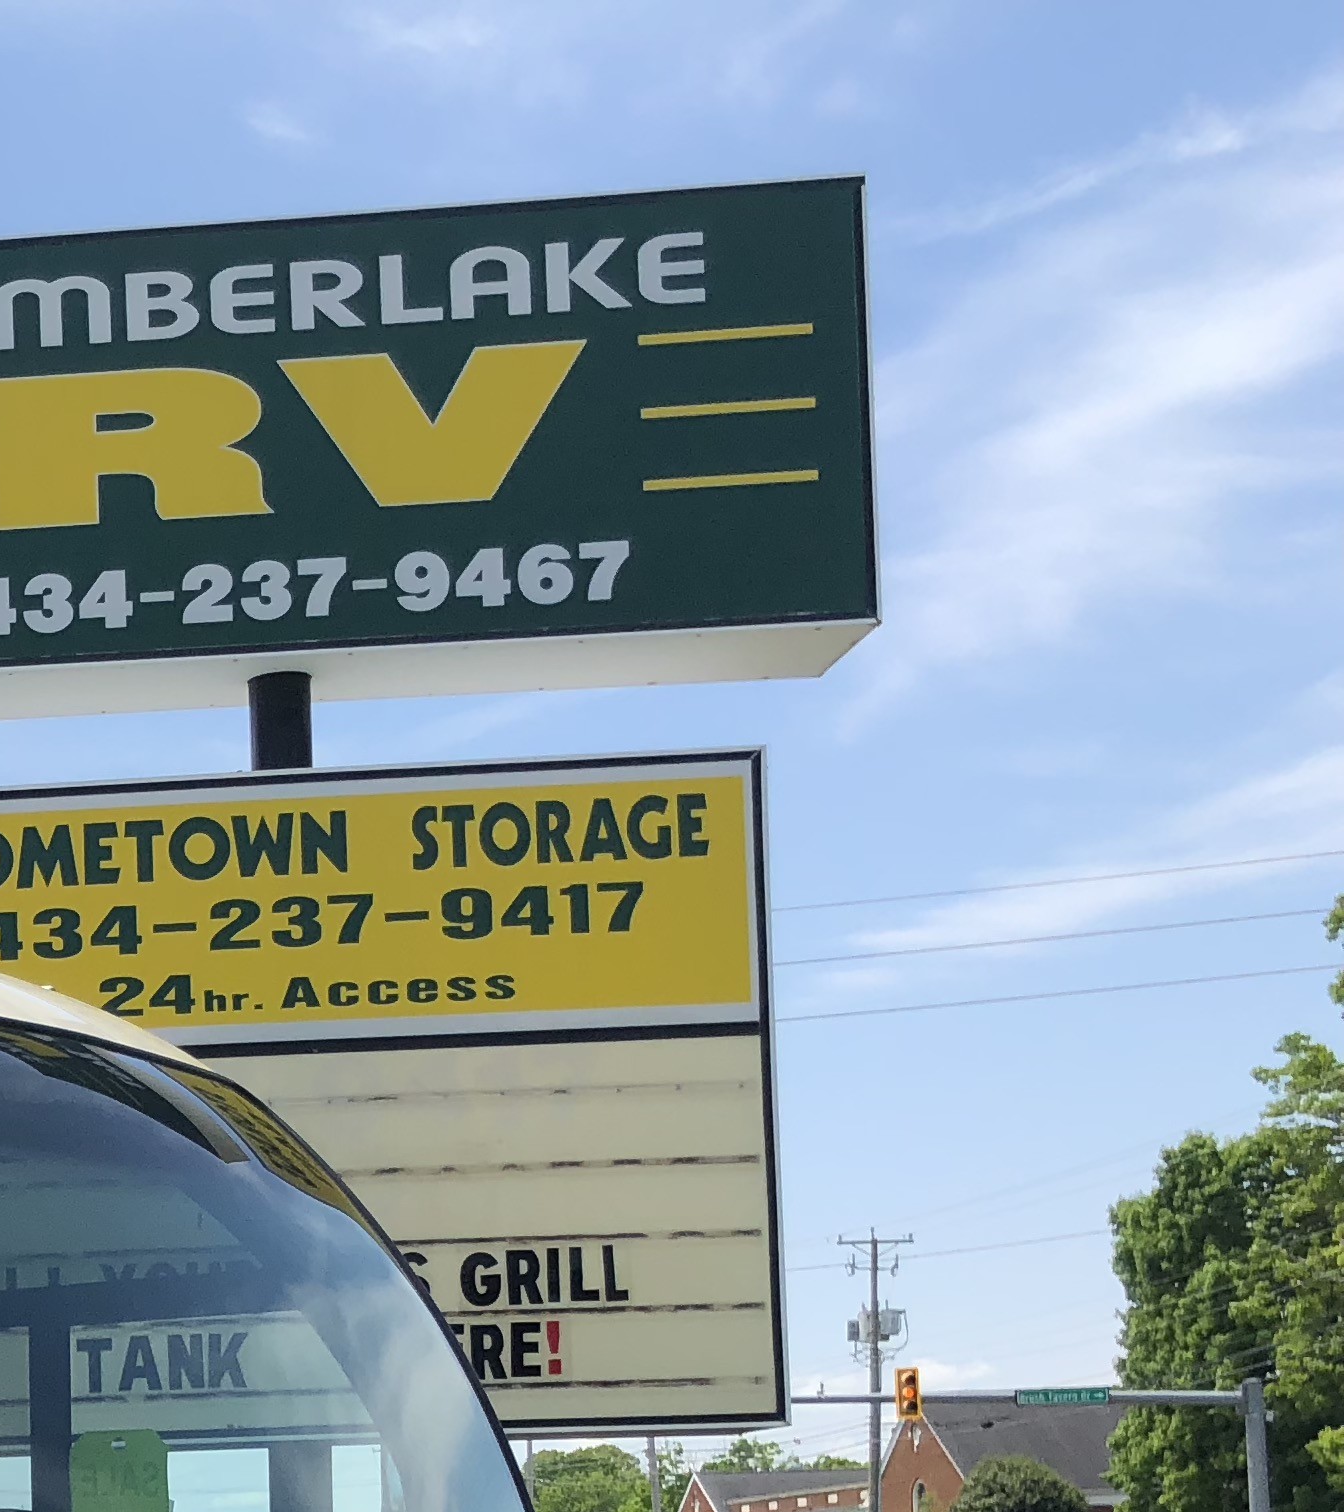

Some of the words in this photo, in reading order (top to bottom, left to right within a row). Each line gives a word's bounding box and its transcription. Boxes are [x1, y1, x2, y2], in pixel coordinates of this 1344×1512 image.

[411, 792, 710, 871] STORAGE
[280, 974, 516, 1009] Access
[459, 1243, 630, 1307] GRILL
[75, 1332, 249, 1394] TANK
[449, 1320, 562, 1380] RE!
